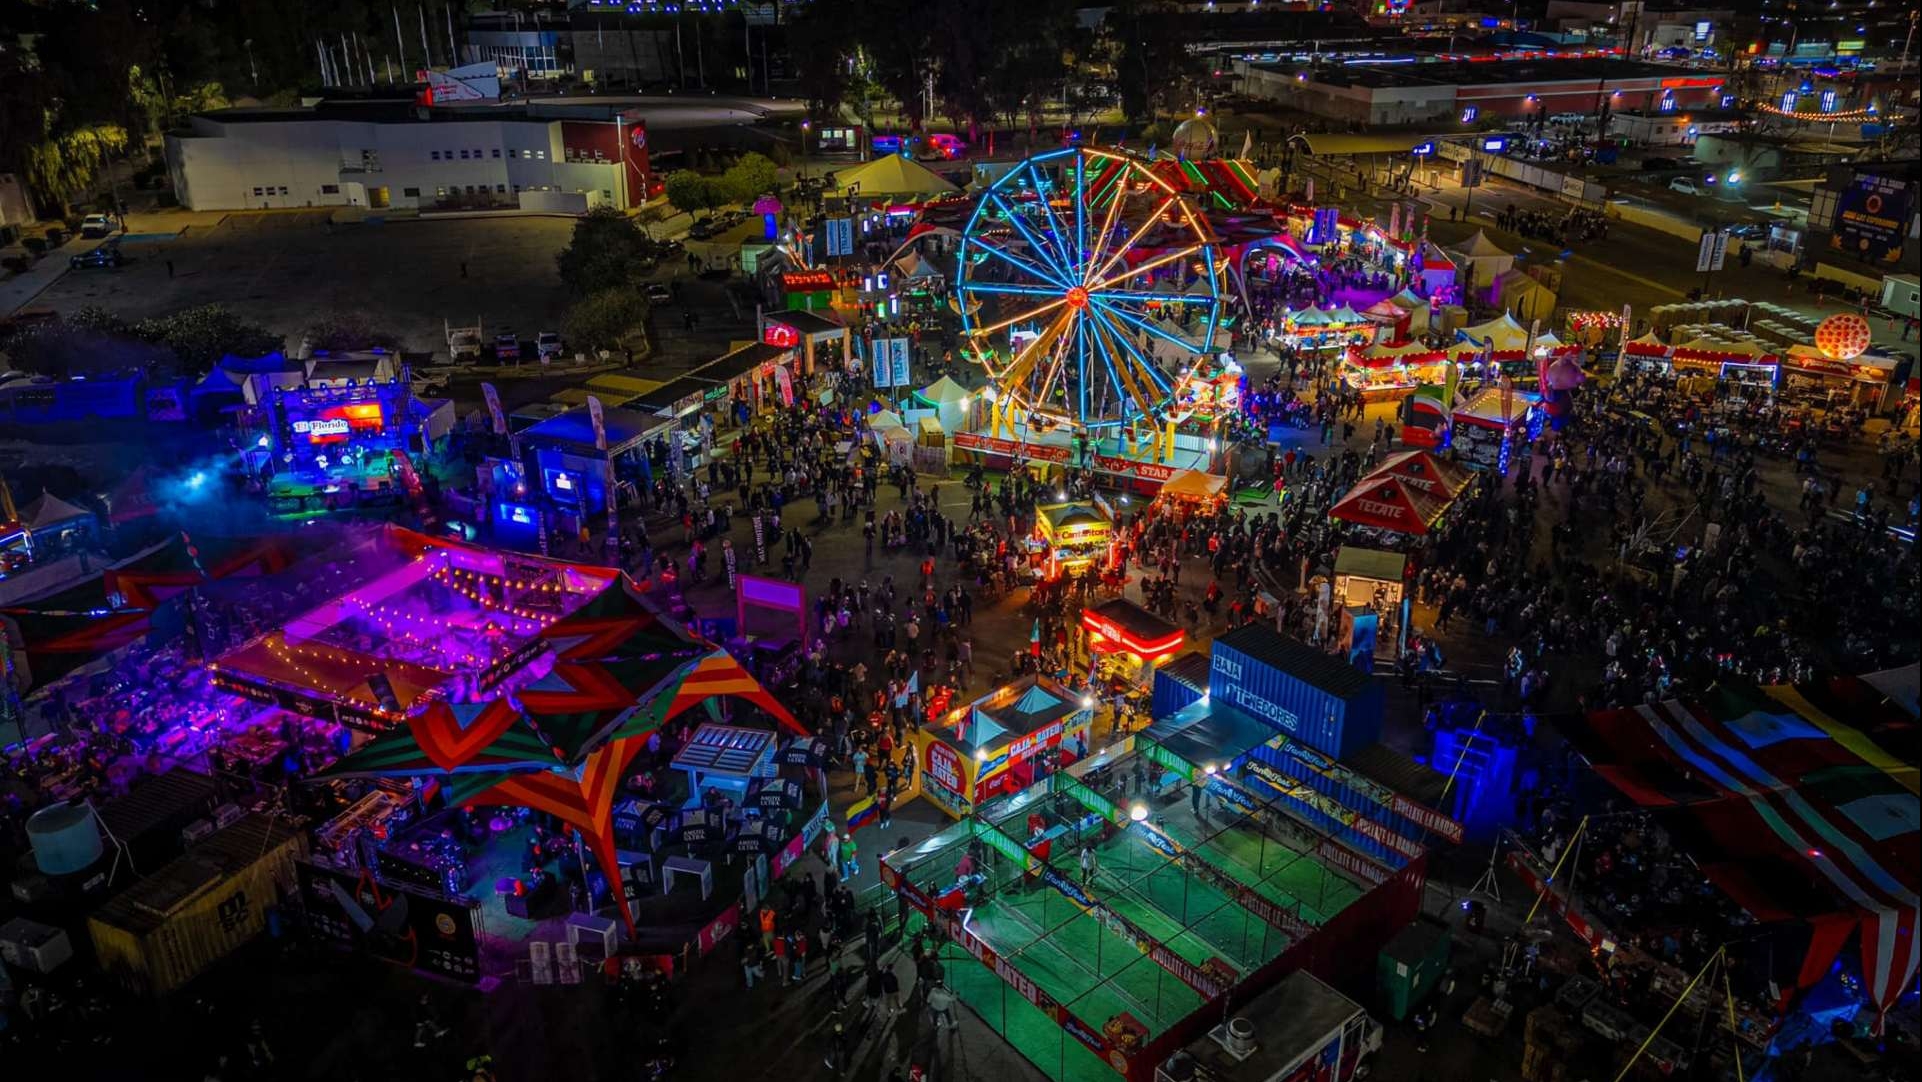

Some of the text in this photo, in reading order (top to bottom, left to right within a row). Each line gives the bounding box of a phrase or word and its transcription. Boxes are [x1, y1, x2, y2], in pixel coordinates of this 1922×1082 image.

[1141, 465, 1168, 480] STAR
[1358, 500, 1406, 518] TECATE
[1214, 655, 1241, 680] BAJA
[1011, 738, 1031, 757] CAJA
[932, 750, 952, 773] CAJA
[951, 921, 1038, 1003] CAJA BATEO
